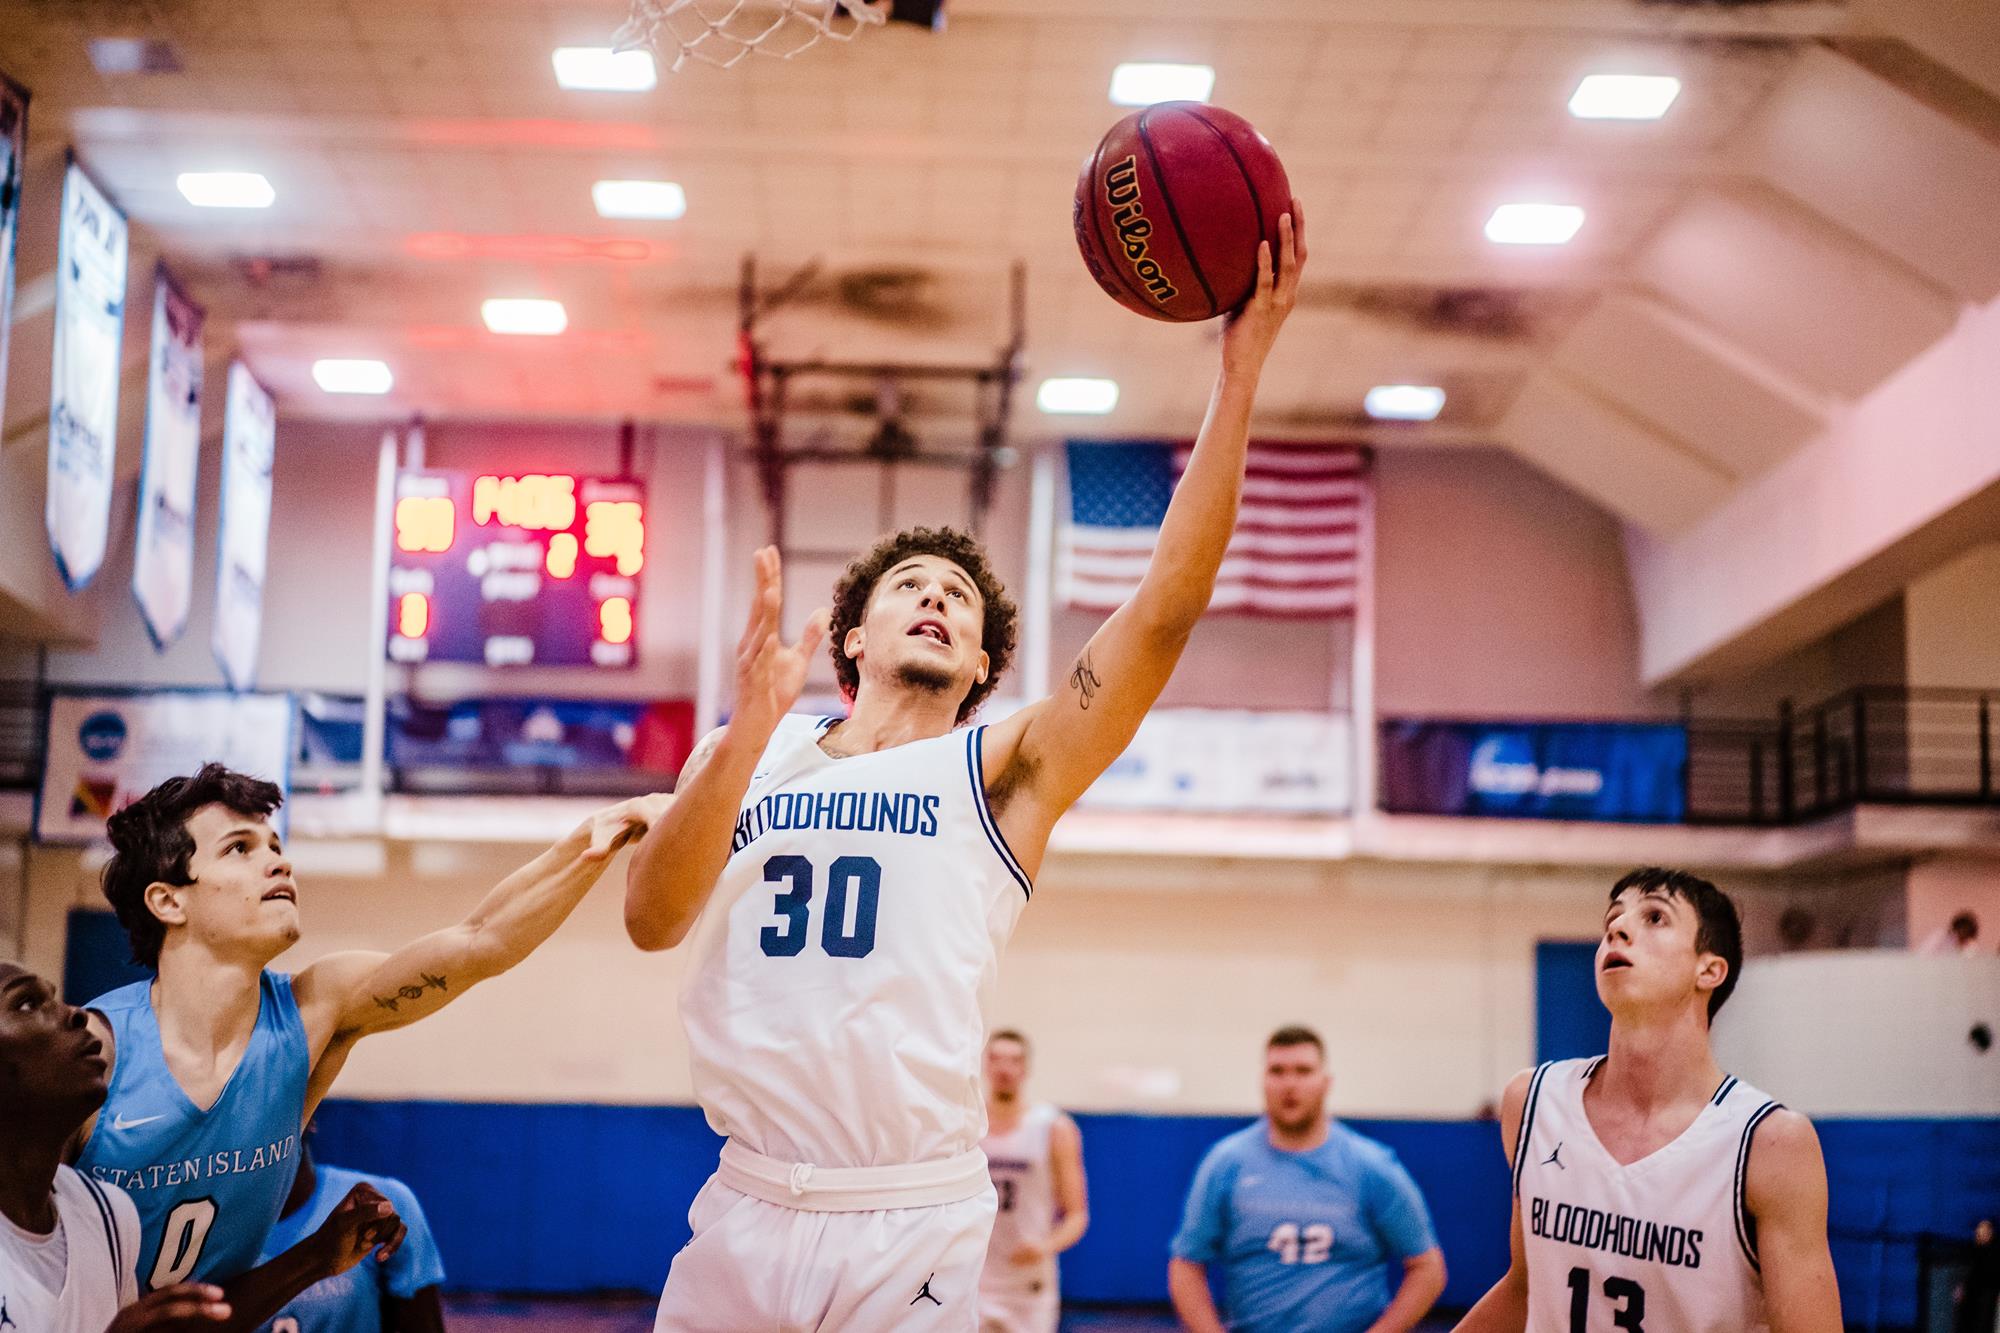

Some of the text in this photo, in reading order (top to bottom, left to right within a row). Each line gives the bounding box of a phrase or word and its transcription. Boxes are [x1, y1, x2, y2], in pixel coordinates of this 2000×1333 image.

[1105, 154, 1179, 303] Wilson
[760, 855, 882, 959] 30
[92, 1134, 296, 1190] STATEN ISLAND
[146, 1195, 219, 1292] 0
[1267, 1222, 1335, 1265] 42
[1532, 1196, 1704, 1269] BLOODHOUNDS
[1567, 1266, 1646, 1333] 13
